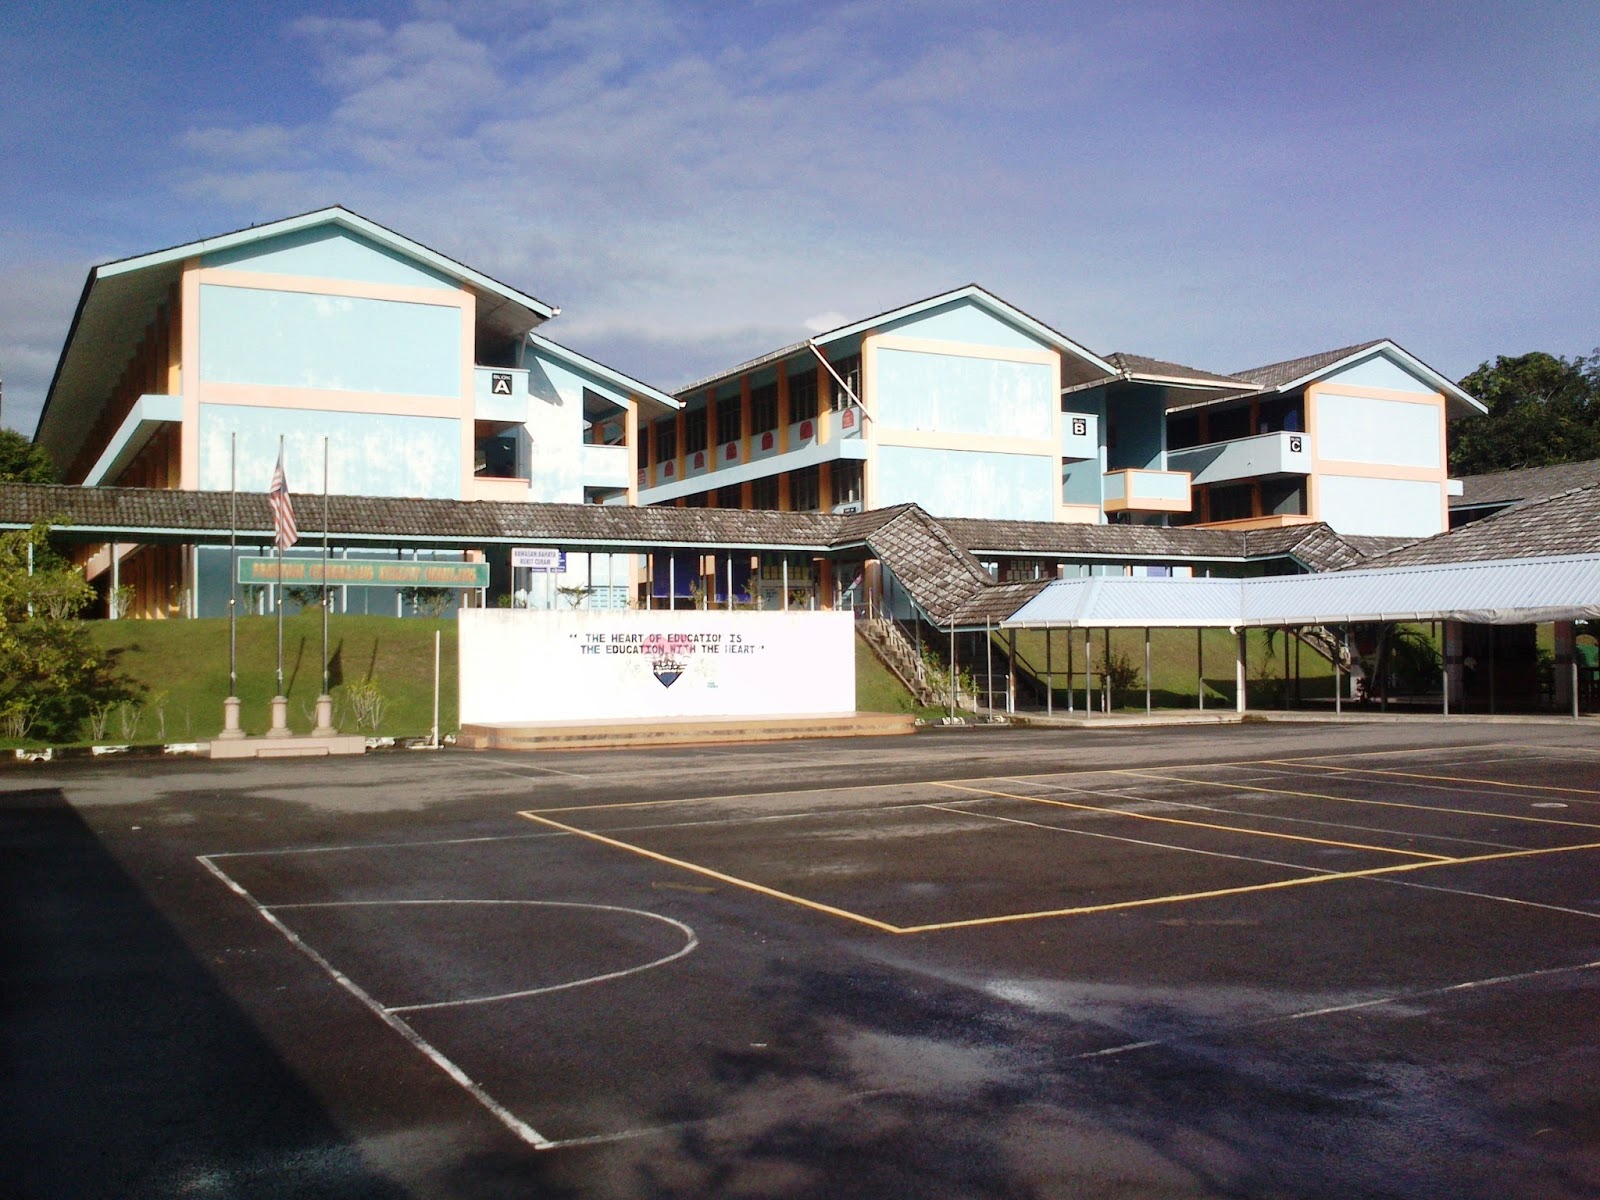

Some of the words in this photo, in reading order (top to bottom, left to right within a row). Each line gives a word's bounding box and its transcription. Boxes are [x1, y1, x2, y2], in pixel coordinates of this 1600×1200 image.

[494, 380, 510, 393] A
[1074, 423, 1085, 435] B
[1291, 441, 1301, 452] C
[585, 633, 606, 643] THE
[611, 633, 644, 643] HEART
[649, 633, 662, 643] OF
[729, 634, 742, 643] IS
[580, 645, 601, 654] THE
[605, 645, 665, 654] EDUCATION
[669, 645, 696, 654] WITH
[701, 645, 720, 654] THE
[724, 645, 755, 654] HEART
